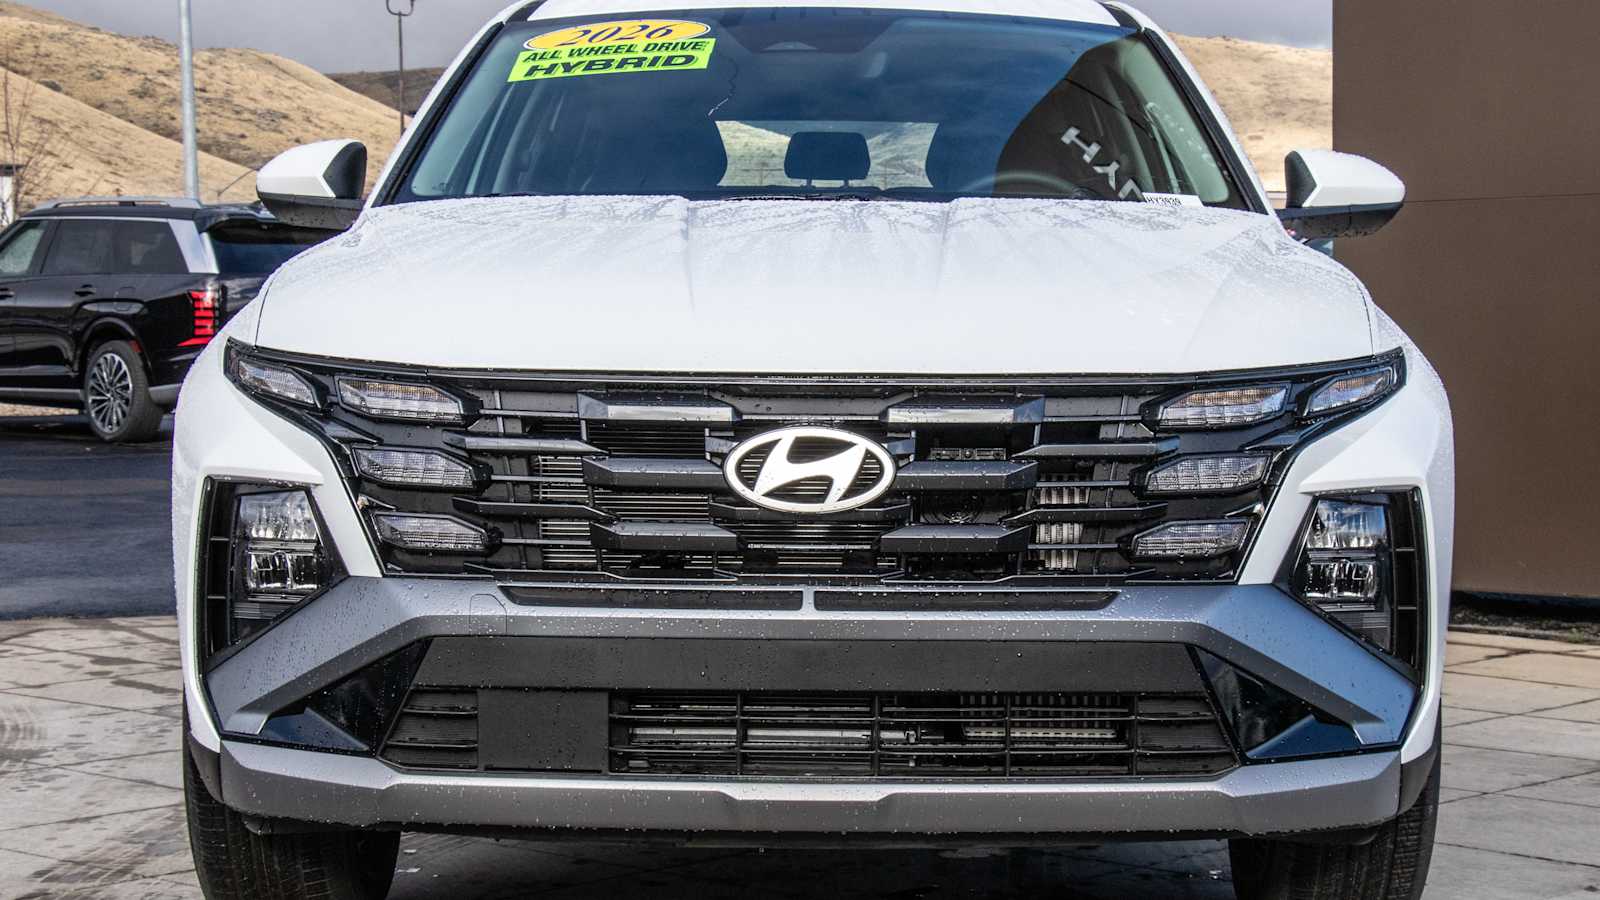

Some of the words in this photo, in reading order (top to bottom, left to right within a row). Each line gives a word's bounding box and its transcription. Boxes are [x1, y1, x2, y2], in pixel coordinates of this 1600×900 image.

[557, 24, 673, 47] 2026
[524, 52, 561, 62] ALL
[570, 44, 637, 57] WHEEL
[646, 41, 707, 51] DRIVE
[524, 54, 696, 77] HYBRID
